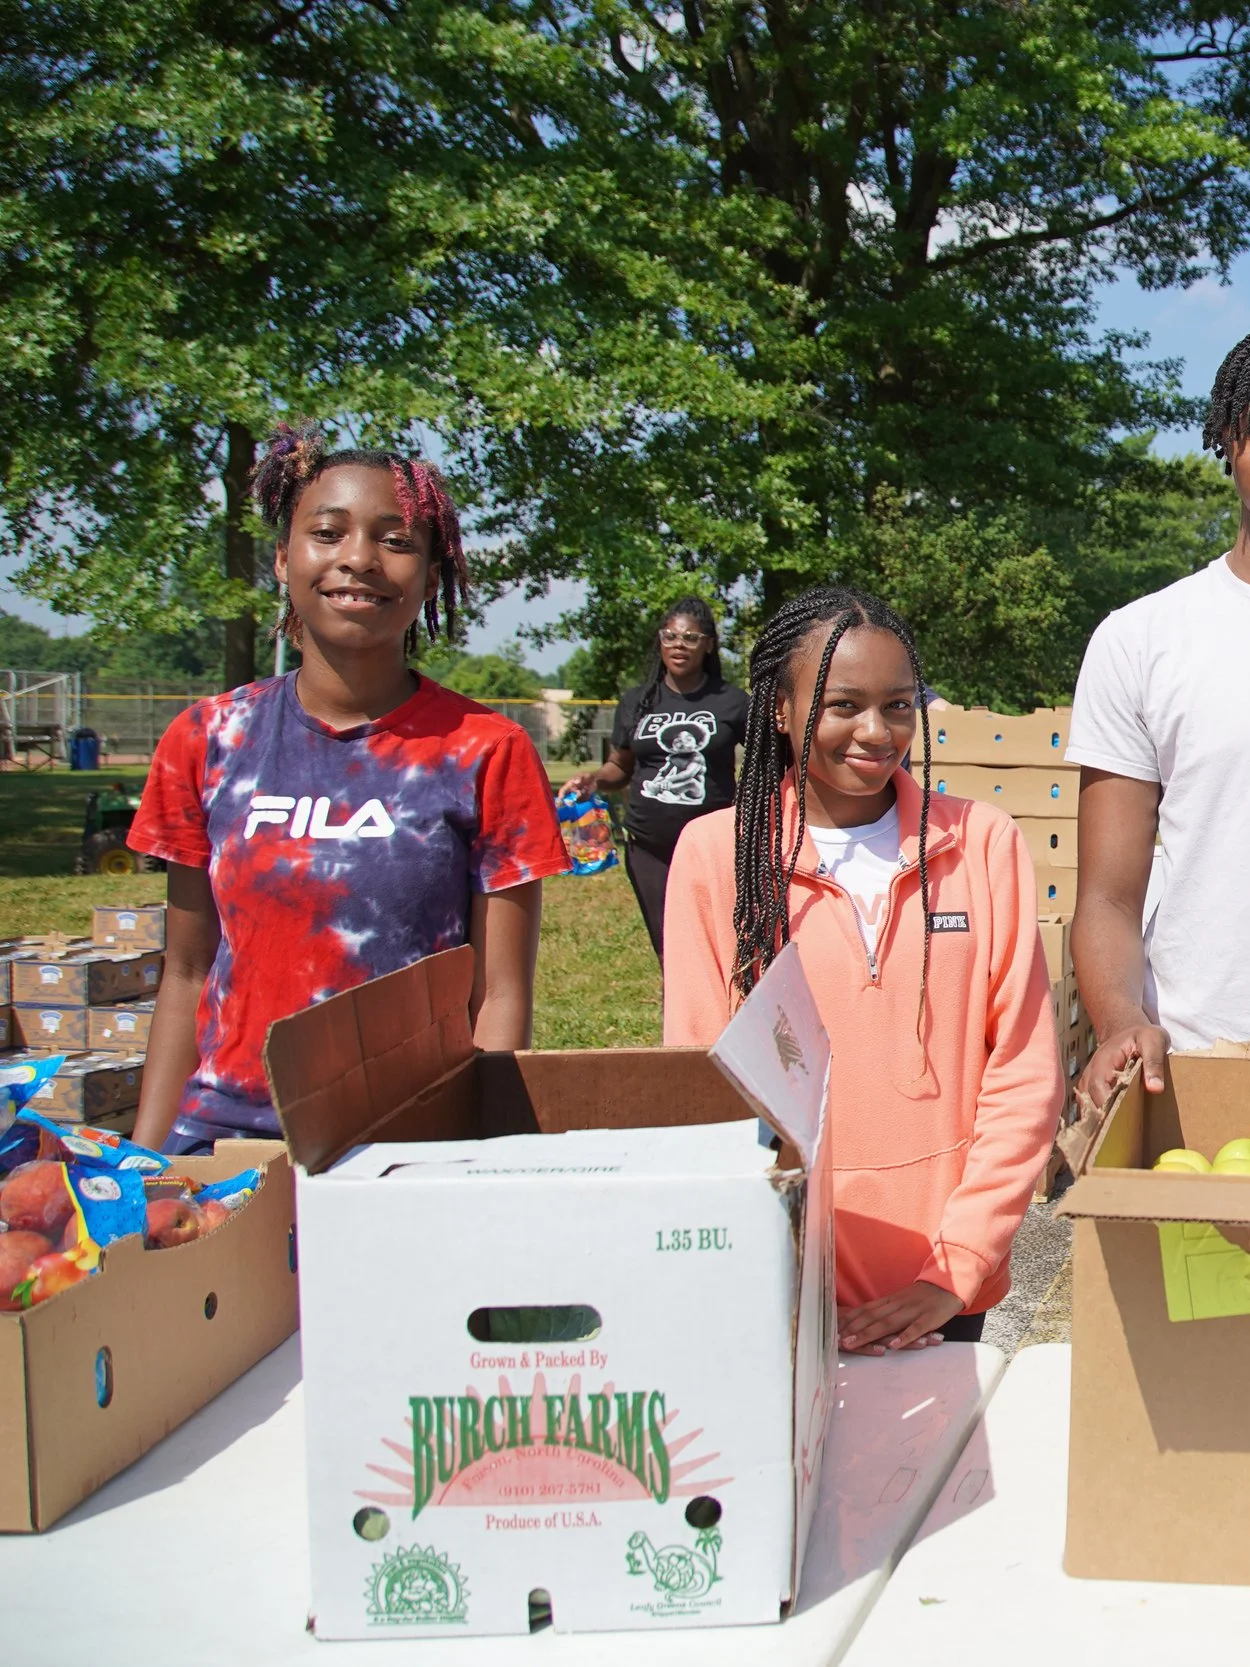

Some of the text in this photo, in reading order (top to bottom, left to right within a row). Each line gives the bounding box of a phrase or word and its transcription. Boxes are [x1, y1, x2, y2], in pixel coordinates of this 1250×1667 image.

[636, 710, 717, 739] BIG
[243, 796, 396, 840] FILA
[933, 915, 967, 928] PINK
[656, 1227, 733, 1251] 1.35 BU.
[470, 1349, 608, 1370] Grown & Packed By
[409, 1389, 670, 1521] BURCH FARMS
[514, 1447, 561, 1461] North
[566, 1447, 626, 1489] Carolina
[486, 1511, 602, 1530] Produce of U.S.A.
